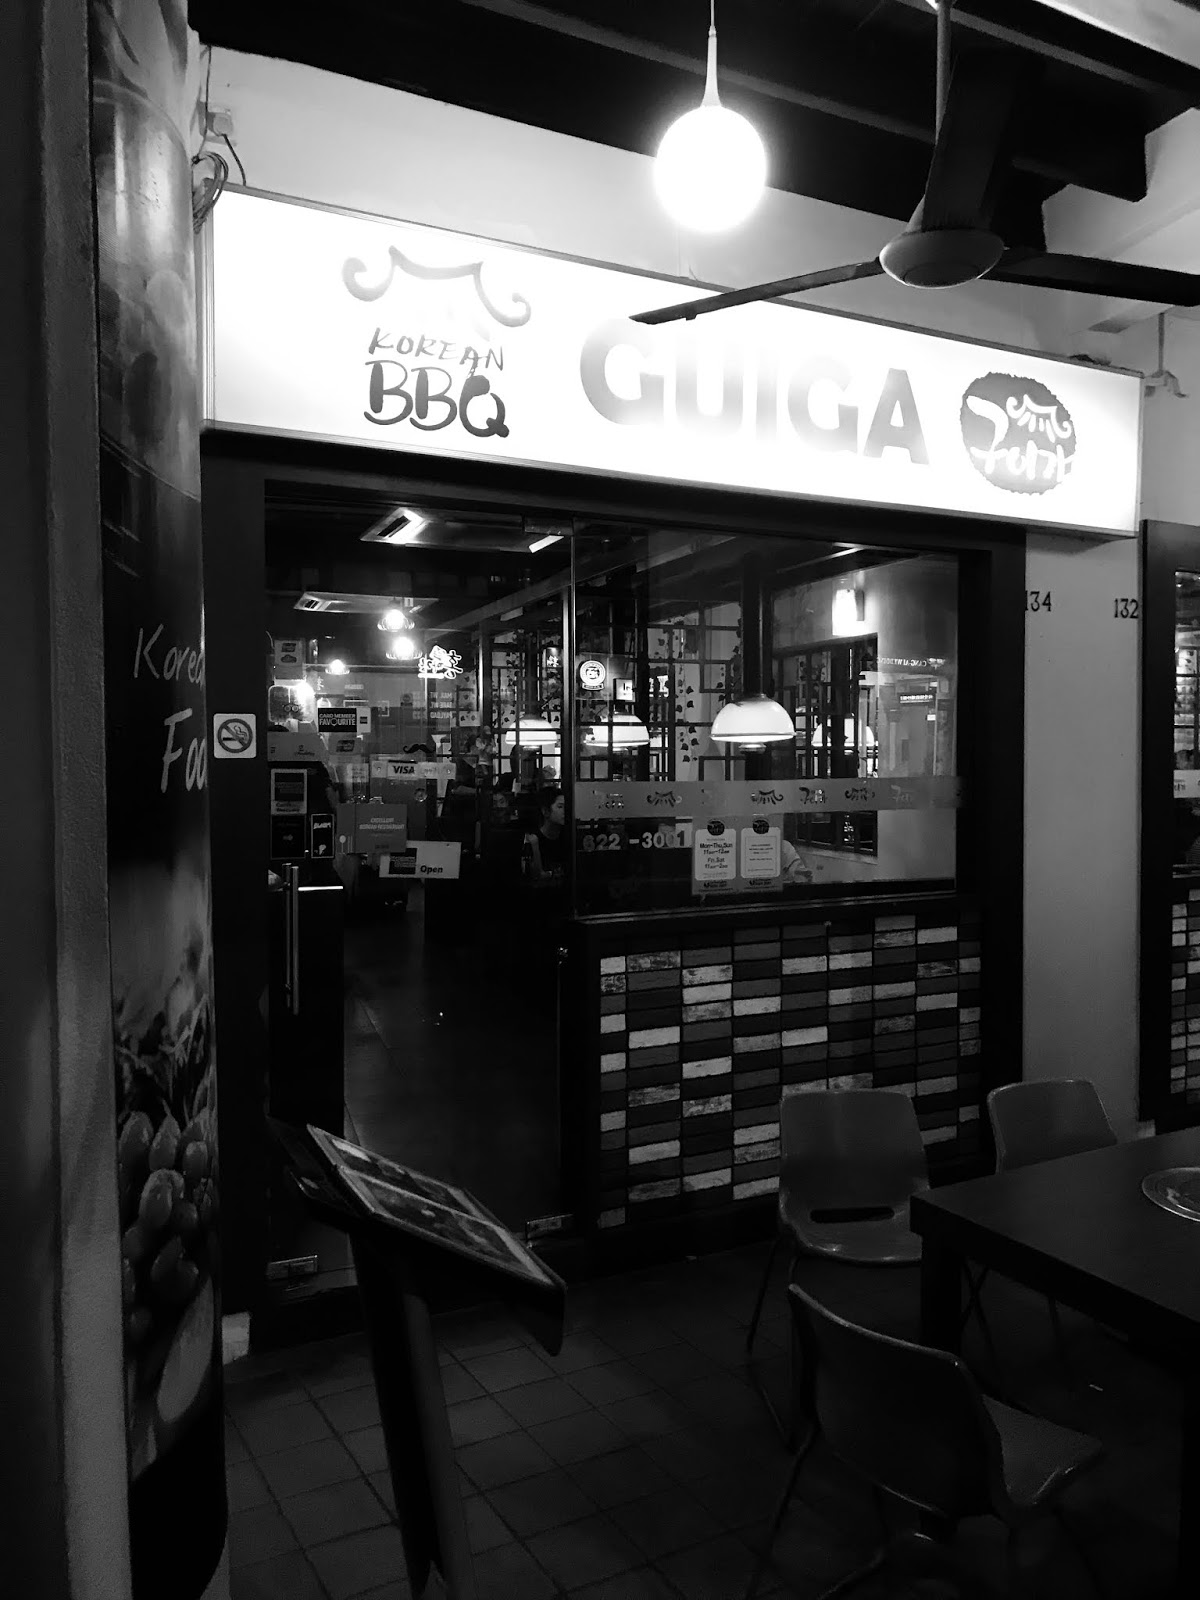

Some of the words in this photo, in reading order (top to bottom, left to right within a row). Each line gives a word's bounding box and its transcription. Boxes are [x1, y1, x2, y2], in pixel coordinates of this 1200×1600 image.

[368, 327, 505, 372] KOREAN
[362, 359, 511, 439] BBQ
[579, 317, 930, 466] GUIGA
[1025, 590, 1052, 612] 134
[1114, 598, 1139, 619] 132
[319, 718, 356, 726] FAVOURITE
[392, 765, 416, 774] VISA
[419, 865, 444, 875] Open
